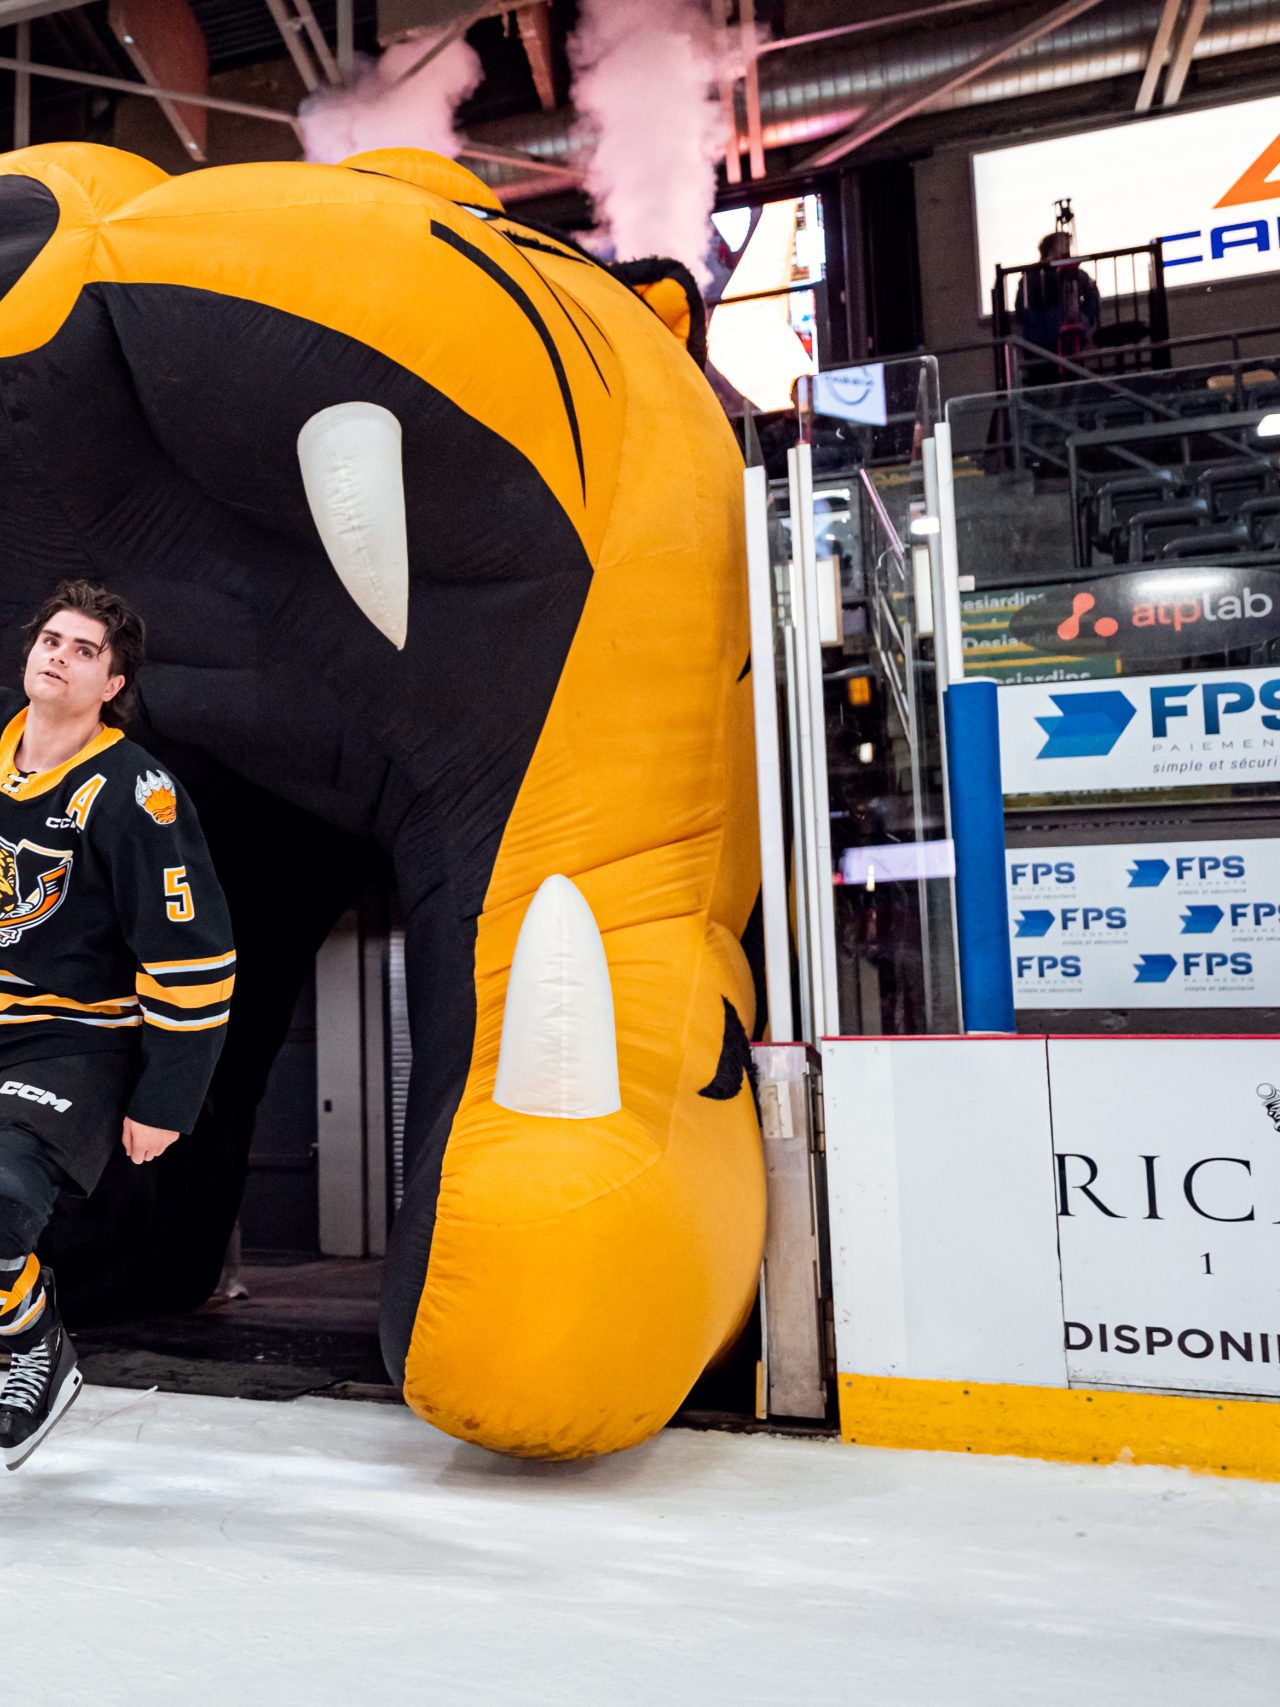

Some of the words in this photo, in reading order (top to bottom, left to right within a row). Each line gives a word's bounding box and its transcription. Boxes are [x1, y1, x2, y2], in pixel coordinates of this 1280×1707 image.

[1161, 216, 1280, 267] CA
[1131, 588, 1273, 632] atplab
[1153, 760, 1203, 774] simple
[1209, 759, 1224, 771] et
[1230, 754, 1280, 769] sécuri
[65, 773, 108, 831] A
[1011, 862, 1075, 885] FPS
[1176, 855, 1245, 880] FPS
[163, 866, 195, 922] 5
[1061, 907, 1127, 930] FPS
[1230, 902, 1280, 926] FP
[1016, 955, 1081, 978] FPS
[1183, 952, 1253, 976] FPS
[0, 1080, 72, 1113] CCM
[1054, 1153, 1280, 1224] RIC
[1064, 1321, 1280, 1364] DISPONI
